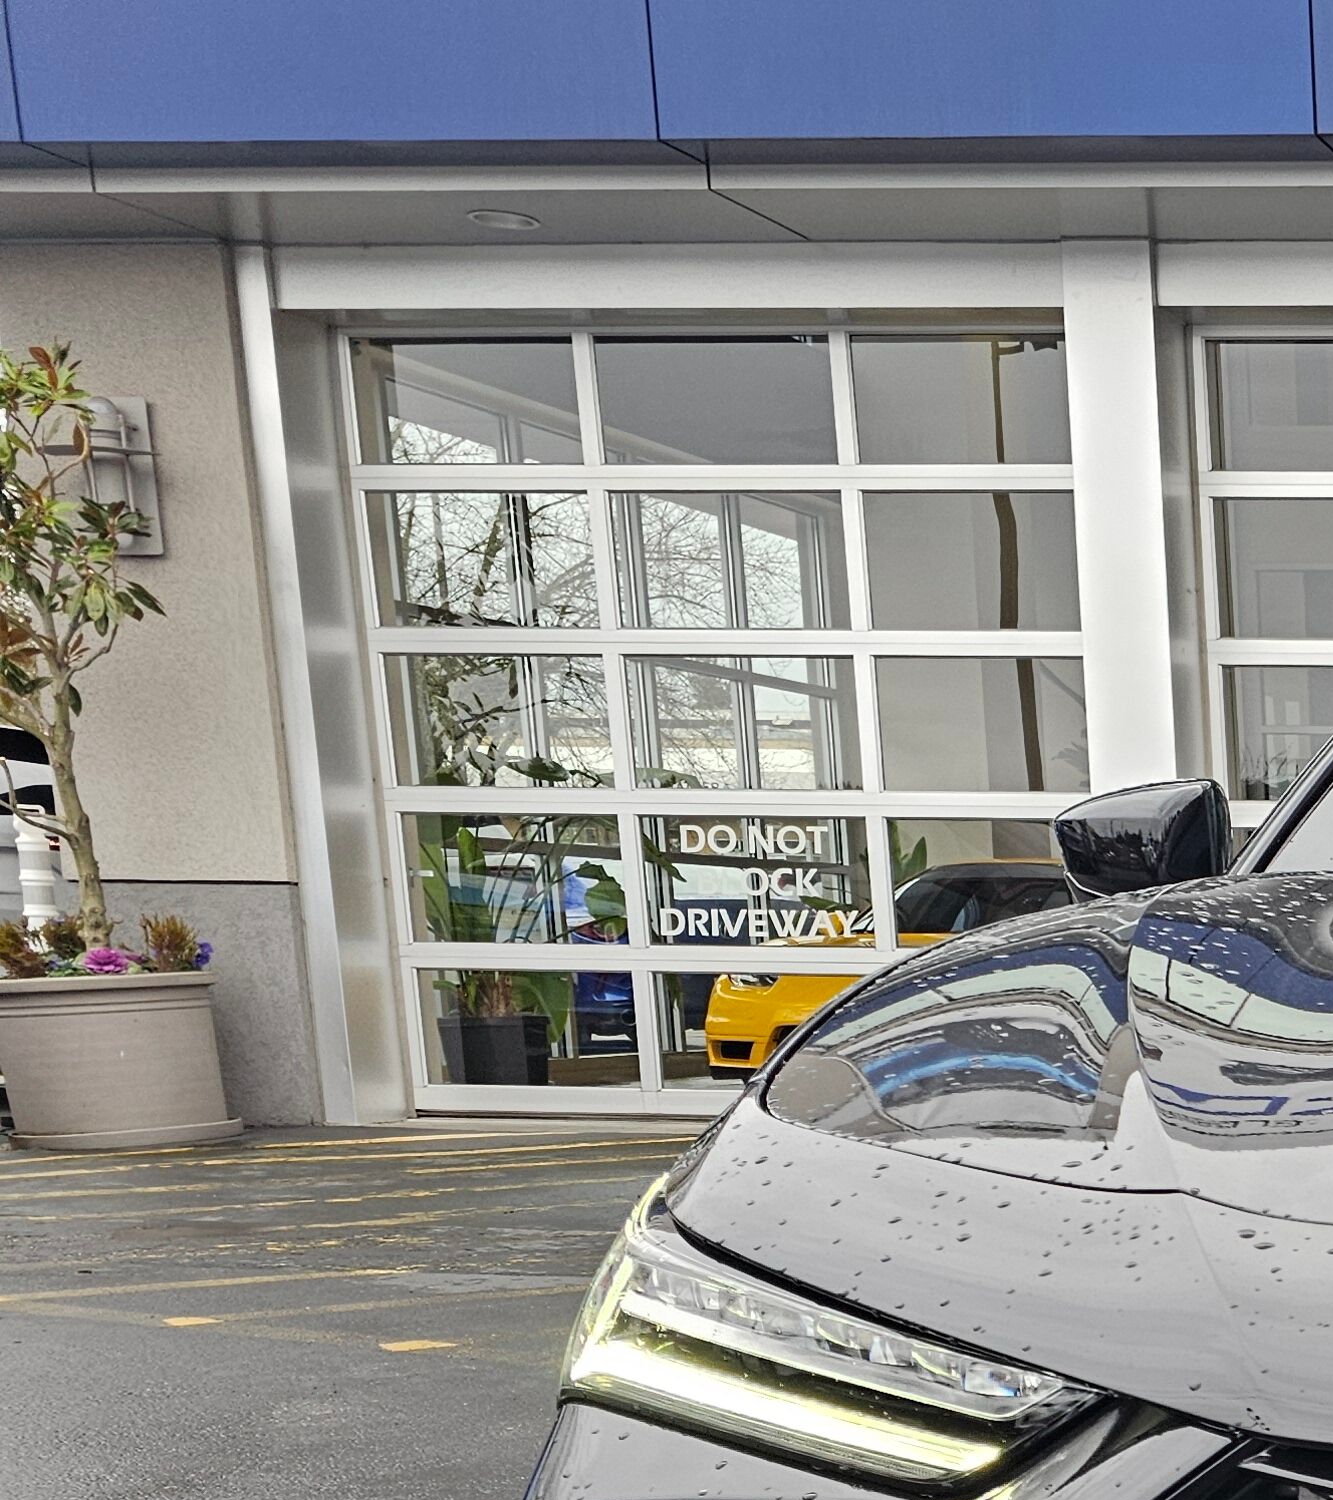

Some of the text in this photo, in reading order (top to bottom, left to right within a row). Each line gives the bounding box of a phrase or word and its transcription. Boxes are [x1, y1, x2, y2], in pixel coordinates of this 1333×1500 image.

[679, 824, 828, 855] DO NOT
[659, 908, 860, 938] DRIVEWAY
